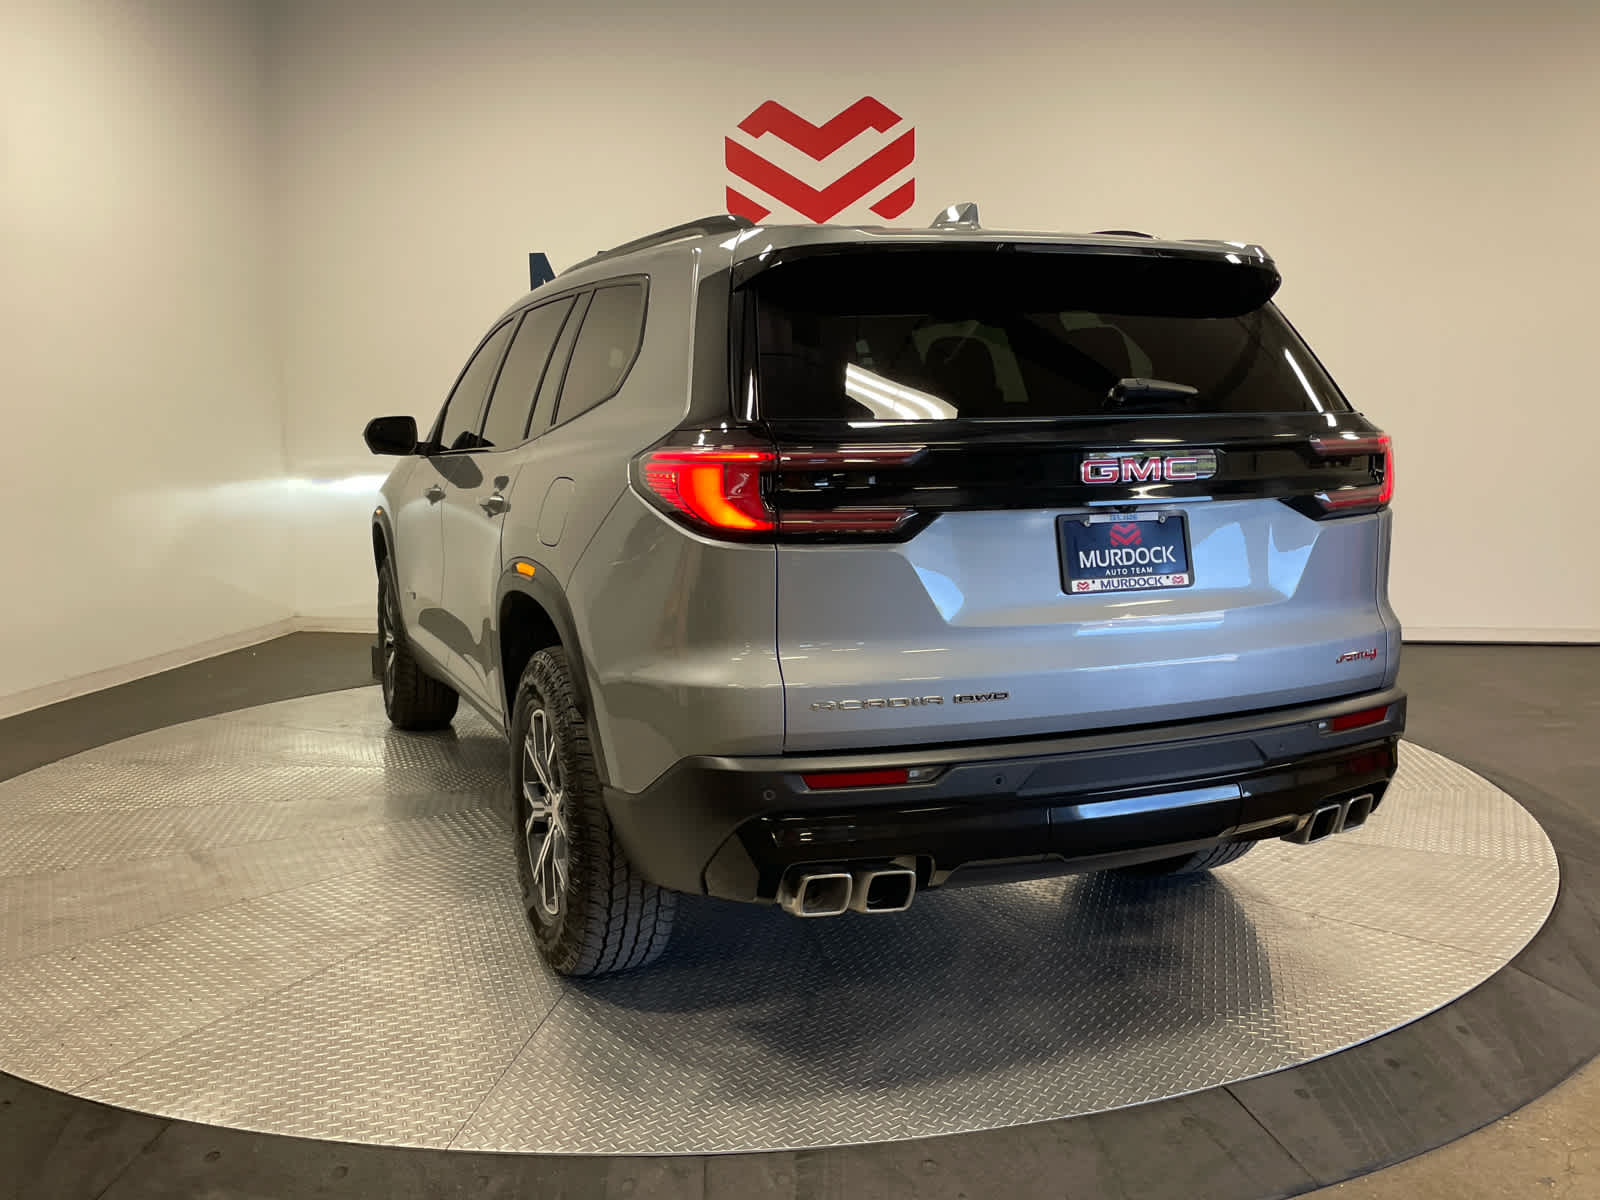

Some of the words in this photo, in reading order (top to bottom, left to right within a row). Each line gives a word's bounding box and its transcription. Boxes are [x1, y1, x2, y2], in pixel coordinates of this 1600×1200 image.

[1081, 457, 1197, 484] GMC
[1079, 545, 1177, 568] MURDOCK
[1105, 568, 1127, 576] AUTO
[1100, 577, 1164, 589] MURDOCK
[809, 696, 944, 712] ACADIA
